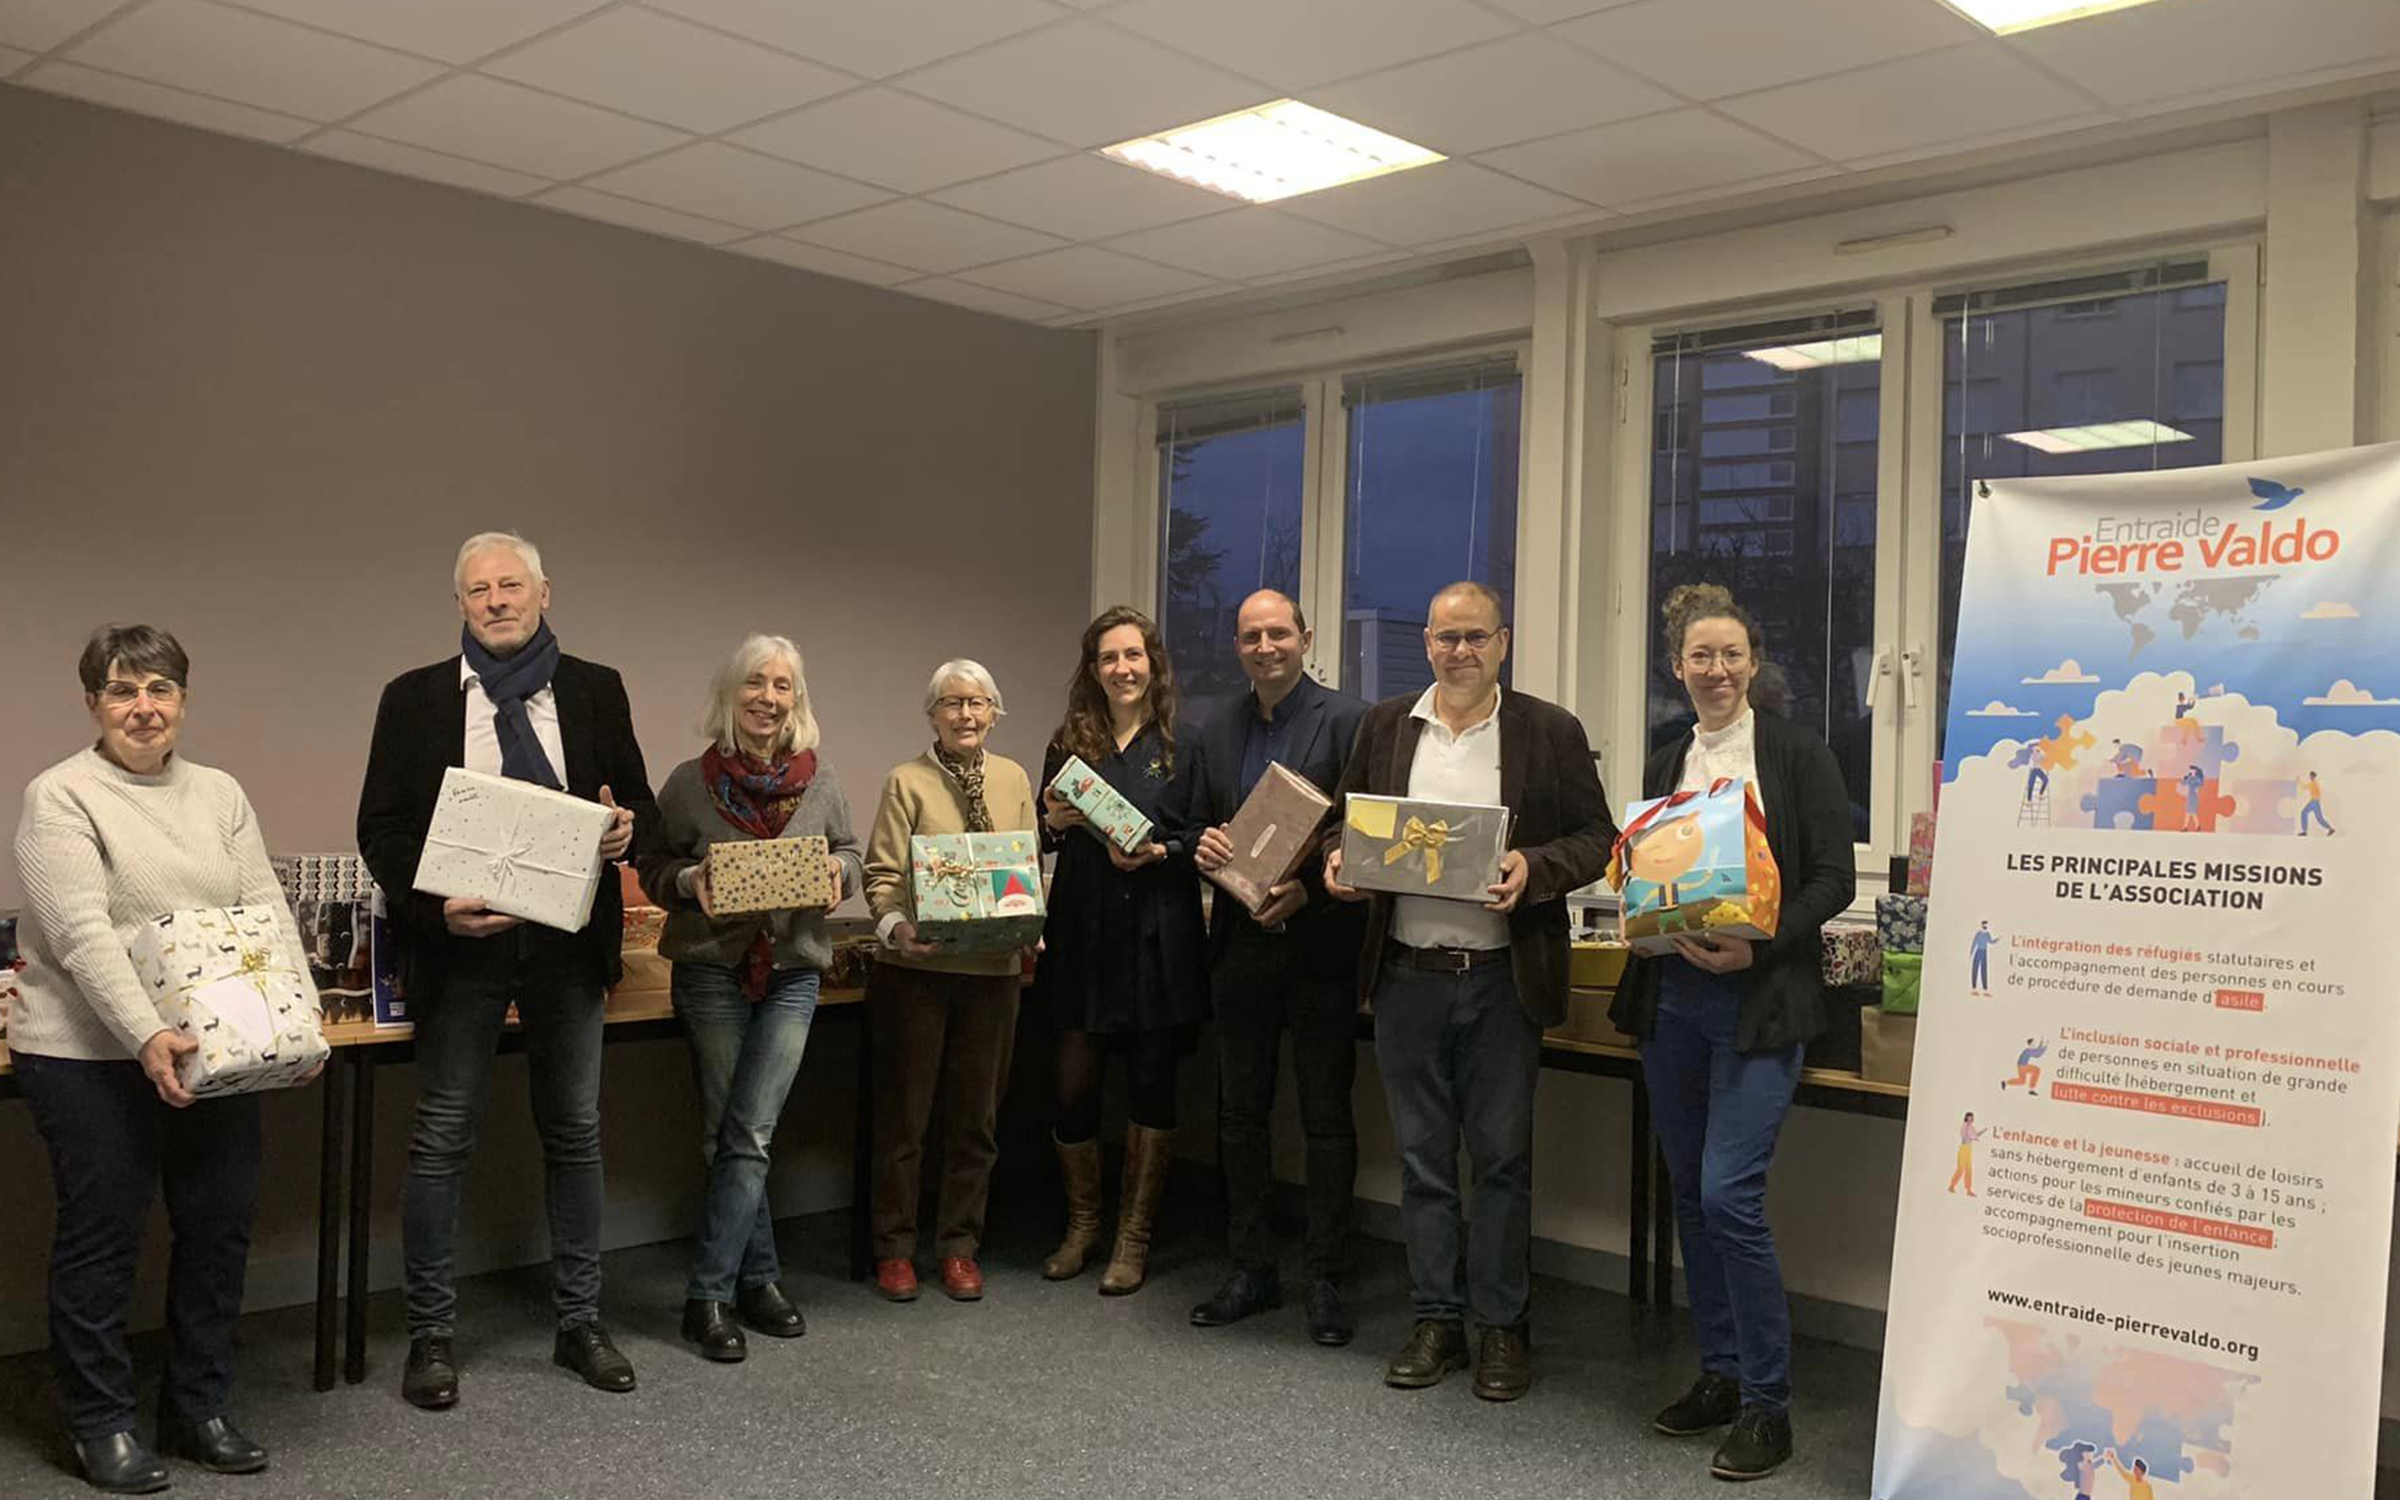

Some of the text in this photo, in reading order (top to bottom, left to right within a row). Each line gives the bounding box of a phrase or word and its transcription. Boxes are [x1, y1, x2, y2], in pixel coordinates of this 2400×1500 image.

[2046, 517, 2341, 577] Pierre Valdo
[2094, 508, 2221, 545] Entraide
[2006, 853, 2324, 887] LES PRINCIPALES MISSIONS
[2055, 880, 2264, 911] DE L'ASSOCIATION
[2008, 953, 2346, 997] l'accompagnement des personnes en cours
[2010, 934, 2316, 973] L'intégration des réfugiés statutaires et
[2007, 973, 2025, 987] de
[2027, 975, 2101, 994] procédure
[2103, 981, 2123, 996] de
[2126, 983, 2198, 1003] demande
[2057, 1046, 2348, 1094] de personnes en situation de grande
[2059, 1026, 2361, 1074] L'inclusion sociale et professionnelle
[2054, 1084, 2088, 1101] lutte
[2091, 1090, 2140, 1108] contre
[2143, 1096, 2167, 1113] les
[2056, 1066, 2121, 1087] difficulté
[2240, 1090, 2256, 1104] et
[1989, 1147, 2024, 1163] sans
[2026, 1150, 2125, 1179] hébergement
[2128, 1167, 2202, 1192] d'enfants
[2206, 1179, 2227, 1195] de
[2230, 1182, 2241, 1198] 3
[2244, 1184, 2256, 1201] à
[2261, 1187, 2281, 1205] 15
[2284, 1194, 2317, 1211] ans
[1992, 1125, 2060, 1149] L'enfance
[2062, 1138, 2078, 1151] et
[2081, 1139, 2097, 1154] la
[2098, 1141, 2171, 1166] jeunesse
[2183, 1157, 2241, 1177] accueil
[2245, 1164, 2267, 1181] de
[2271, 1167, 2325, 1190] loisirs
[1986, 1186, 2044, 1206] services
[2046, 1194, 2066, 1210] de
[2069, 1198, 2084, 1213] la
[2085, 1201, 2165, 1227] protection
[2168, 1215, 2188, 1231] de
[2192, 1220, 2269, 1246] l'enfance
[1987, 1166, 2297, 1229] actions pour les mineurs confiés par les
[1983, 1205, 2241, 1262] accompagnement pour l'insertion
[1981, 1224, 2302, 1297] socioprofessionnelle des jeunes majeurs.
[1987, 1288, 2260, 1363] www.entraide-pierrevaldo.org
